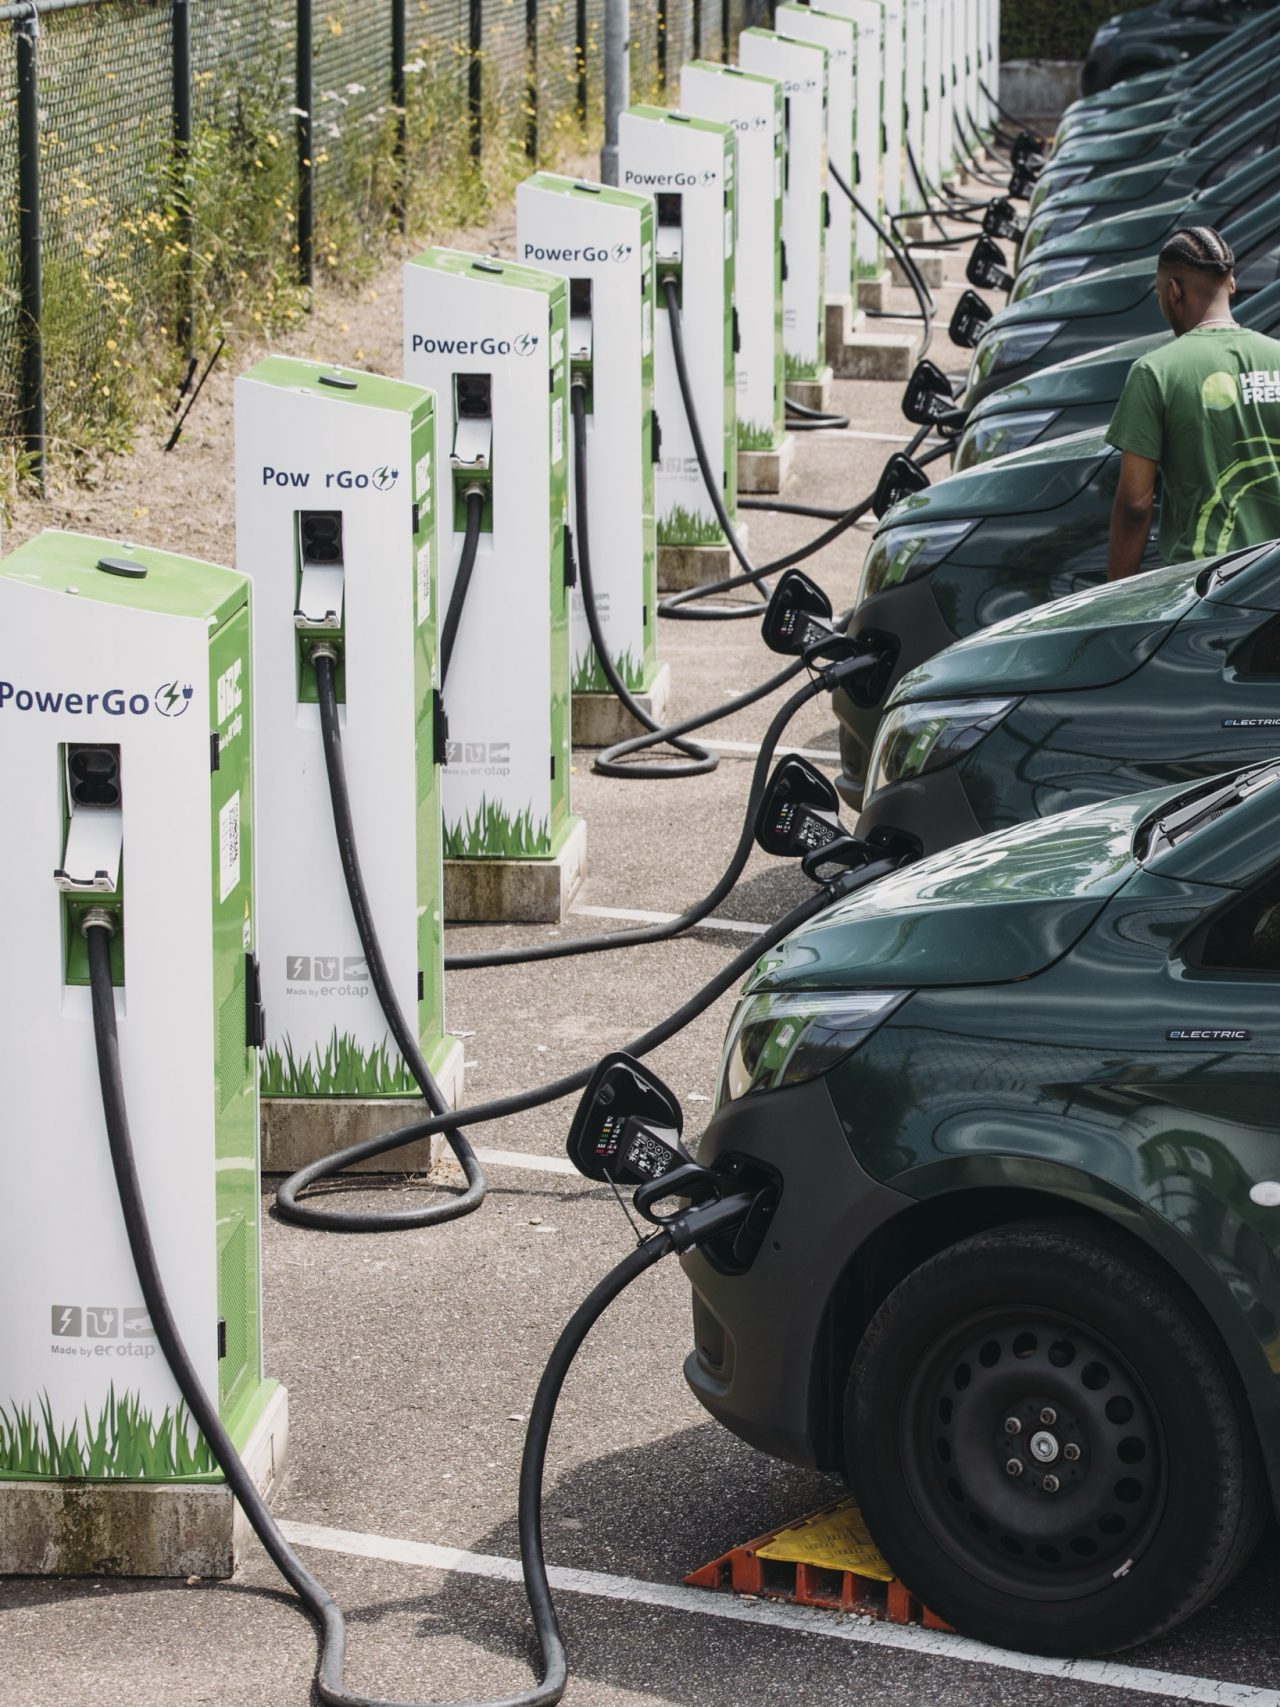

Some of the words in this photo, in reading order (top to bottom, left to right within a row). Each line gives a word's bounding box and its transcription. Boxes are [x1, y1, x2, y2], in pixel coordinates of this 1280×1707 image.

[625, 170, 697, 186] PowerGo
[524, 243, 609, 262] PowerGo
[412, 334, 511, 355] PowerGo
[0, 681, 150, 716] PowerGo
[286, 986, 306, 996] Made
[308, 987, 319, 998] by
[320, 984, 369, 998] ecotap
[51, 1344, 77, 1355] Made
[80, 1346, 93, 1358] by
[94, 1341, 156, 1359] ecotap
